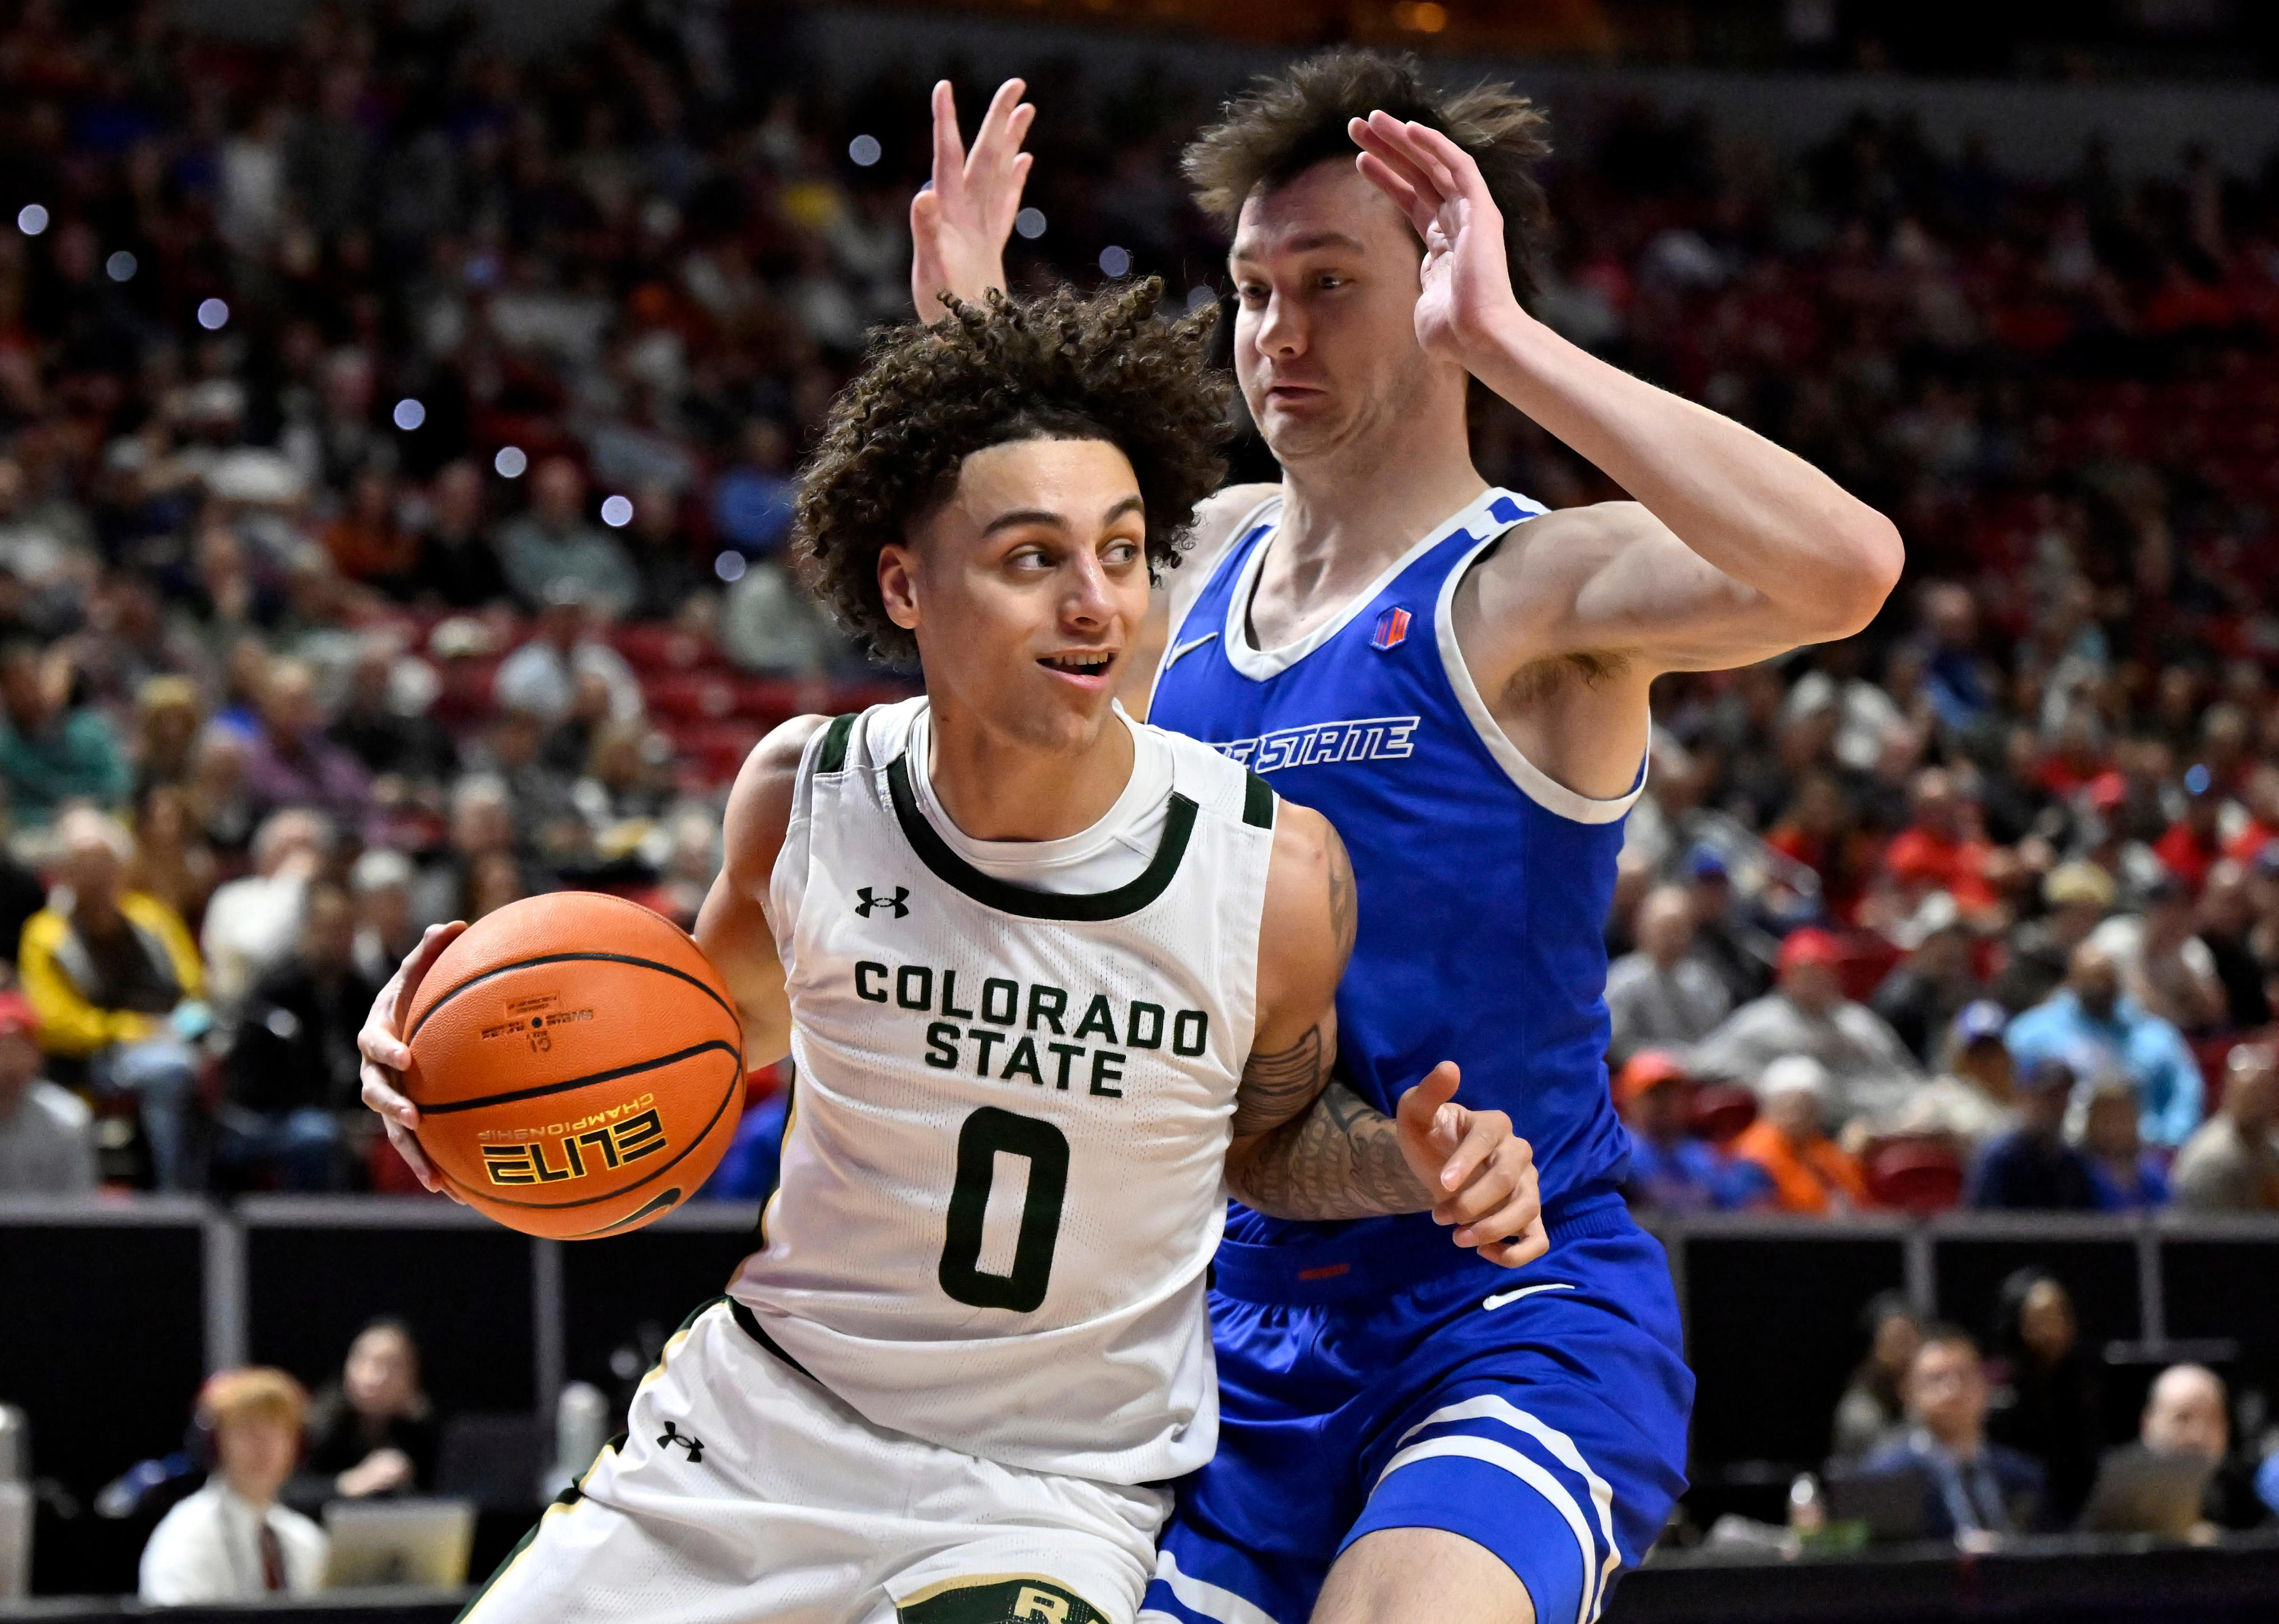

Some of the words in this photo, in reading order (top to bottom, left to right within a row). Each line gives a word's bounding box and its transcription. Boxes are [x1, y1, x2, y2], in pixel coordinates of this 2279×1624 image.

[1255, 716, 1421, 774] STATE
[855, 961, 1208, 1057] COLORADO
[925, 1023, 1126, 1098] STATE
[478, 1093, 654, 1141] CHAMPIONSHIP
[480, 1107, 669, 1185] ELITE
[939, 1106, 1070, 1313] 0
